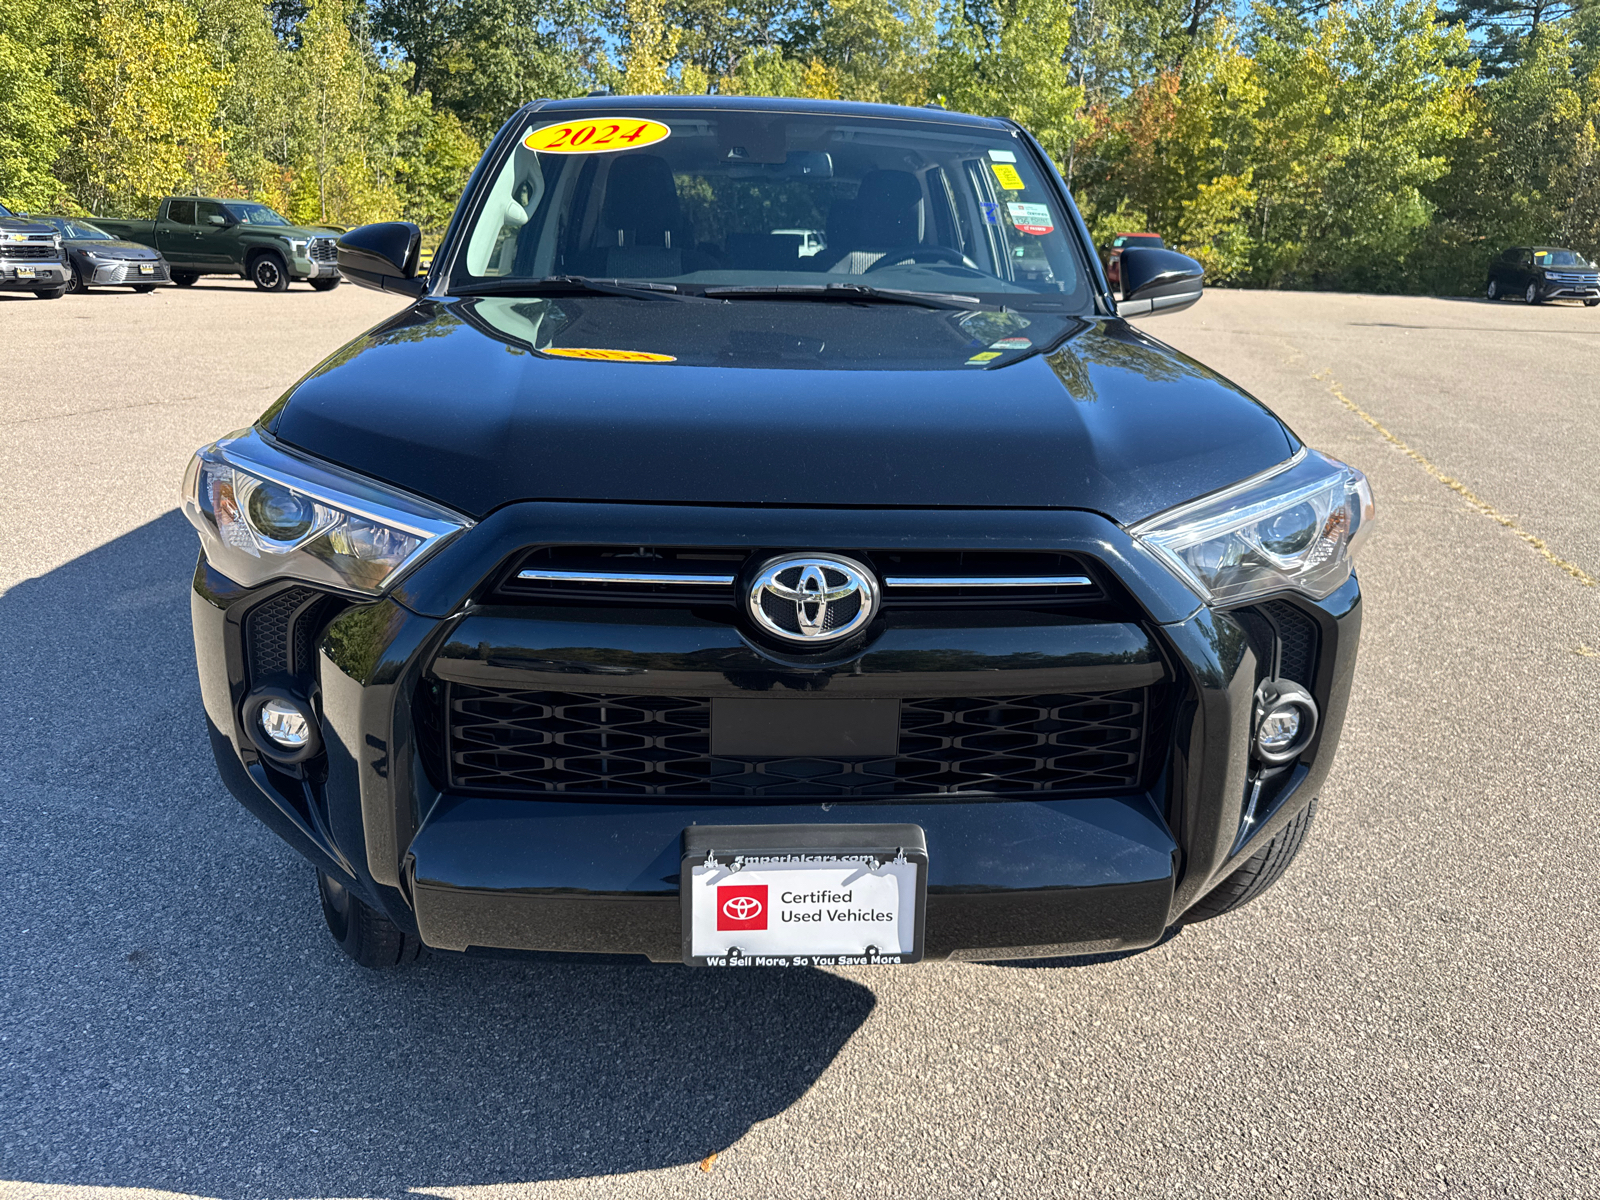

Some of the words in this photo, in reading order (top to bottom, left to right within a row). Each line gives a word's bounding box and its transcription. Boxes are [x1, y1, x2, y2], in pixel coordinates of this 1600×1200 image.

[543, 123, 649, 149] 2024
[780, 889, 853, 904] Certified
[781, 909, 822, 923] Used
[826, 908, 894, 922] Vehicles
[706, 956, 727, 967] We
[729, 956, 752, 967] Sell
[755, 956, 790, 968] More,
[793, 957, 809, 967] So
[811, 956, 835, 966] You
[838, 955, 867, 966] Save
[871, 954, 901, 965] More
